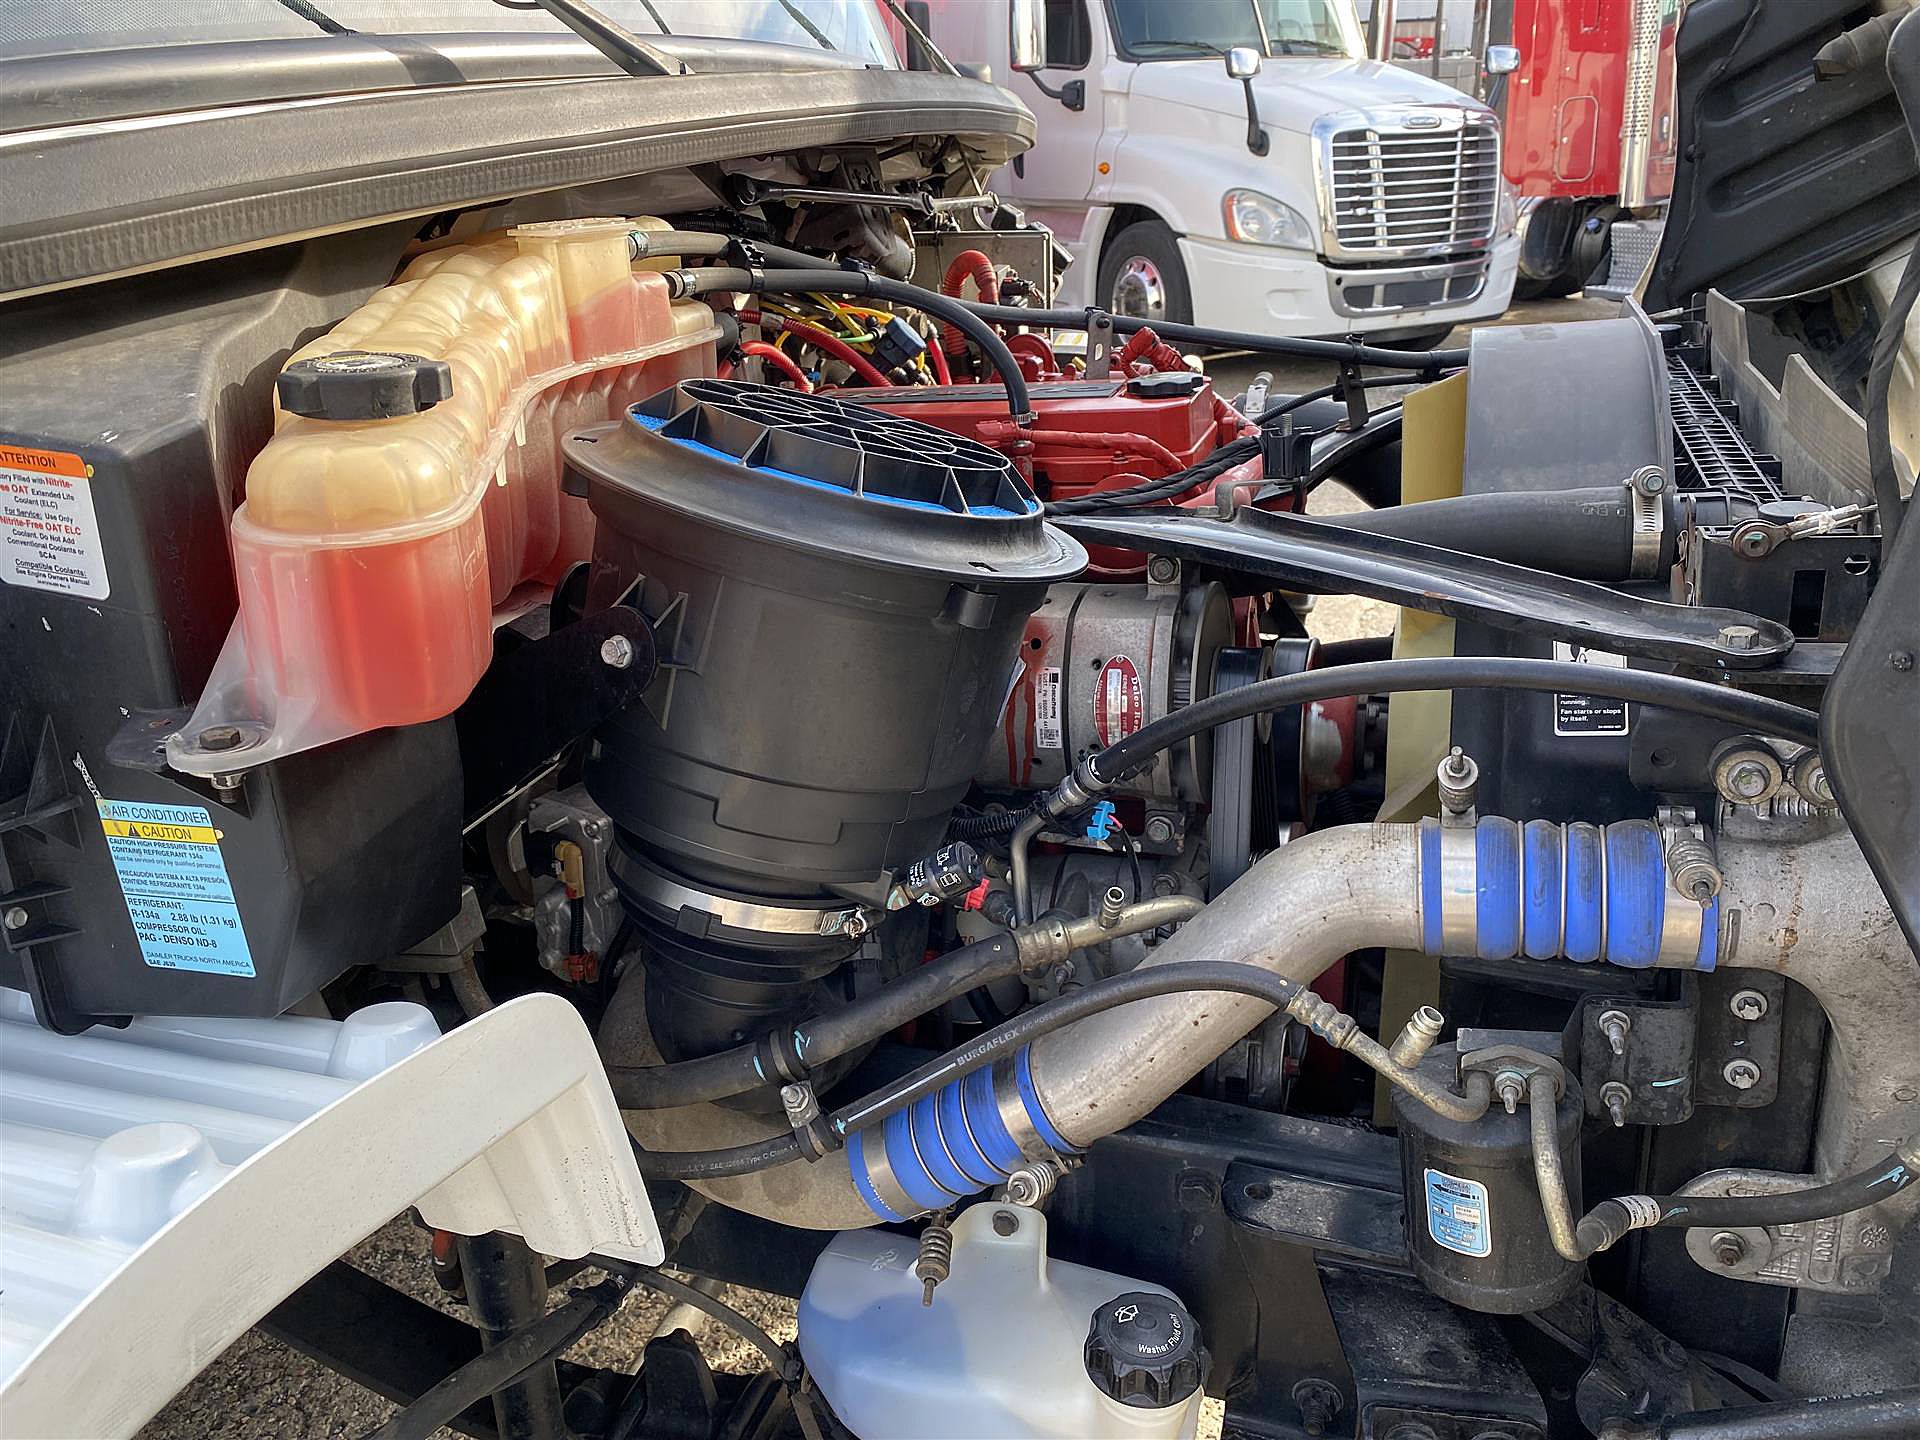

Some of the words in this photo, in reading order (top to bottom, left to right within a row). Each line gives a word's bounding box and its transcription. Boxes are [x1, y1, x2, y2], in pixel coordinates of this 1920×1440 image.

[0, 484, 10, 492] ee
[12, 484, 28, 494] OAT
[31, 488, 61, 499] Extended
[62, 492, 74, 501] Life
[14, 496, 39, 506] Coolant
[40, 499, 58, 510] (ELC)
[4, 506, 15, 516] For
[45, 512, 57, 521] Use
[59, 514, 73, 524] Only
[46, 522, 62, 533] OAT
[64, 526, 81, 536] ELC
[7, 537, 48, 549] Conventional
[49, 543, 76, 554] Coolants
[77, 548, 85, 556] or
[39, 532, 49, 541] Do
[49, 534, 61, 543] Not
[62, 536, 75, 545] Add
[39, 550, 57, 560] SCAs
[16, 558, 53, 571] Compatible
[54, 564, 87, 577] Coolants:
[16, 567, 27, 576] See
[27, 569, 47, 579] Engine
[48, 572, 69, 582] Owners
[69, 577, 90, 586] Manual
[1131, 676, 1140, 708] Delco
[112, 805, 130, 819] AIR
[131, 807, 209, 824] CONDITIONER
[141, 825, 192, 840] CAUTION
[109, 837, 136, 847] CAUTION
[137, 839, 153, 848] HIGH
[153, 841, 187, 851] PRESSURE
[111, 845, 143, 855] CONTAINS
[143, 847, 188, 859] REFRIGERANT
[188, 852, 204, 860] 134a
[114, 854, 125, 862] Must
[127, 897, 185, 910] REFRIGERANT:
[131, 909, 160, 920] R-134a
[170, 912, 189, 922] 2.88
[190, 913, 199, 923] lb
[200, 915, 220, 926] (1.31
[222, 916, 237, 929] kg)
[135, 921, 189, 934] COMPRESSOR
[191, 927, 207, 936] OIL:
[139, 933, 157, 942] PAG
[163, 934, 194, 946] DENSO
[196, 938, 218, 949] ND-8
[146, 951, 173, 960] DAIMLER
[173, 954, 199, 963] TRUCKS
[199, 956, 221, 965] NORTH
[222, 959, 250, 968] AMERICA
[148, 958, 161, 966] SAE
[957, 1027, 1020, 1066] BURGAFLEX
[1138, 1343, 1169, 1354] Washer
[1168, 1328, 1181, 1347] Fluid
